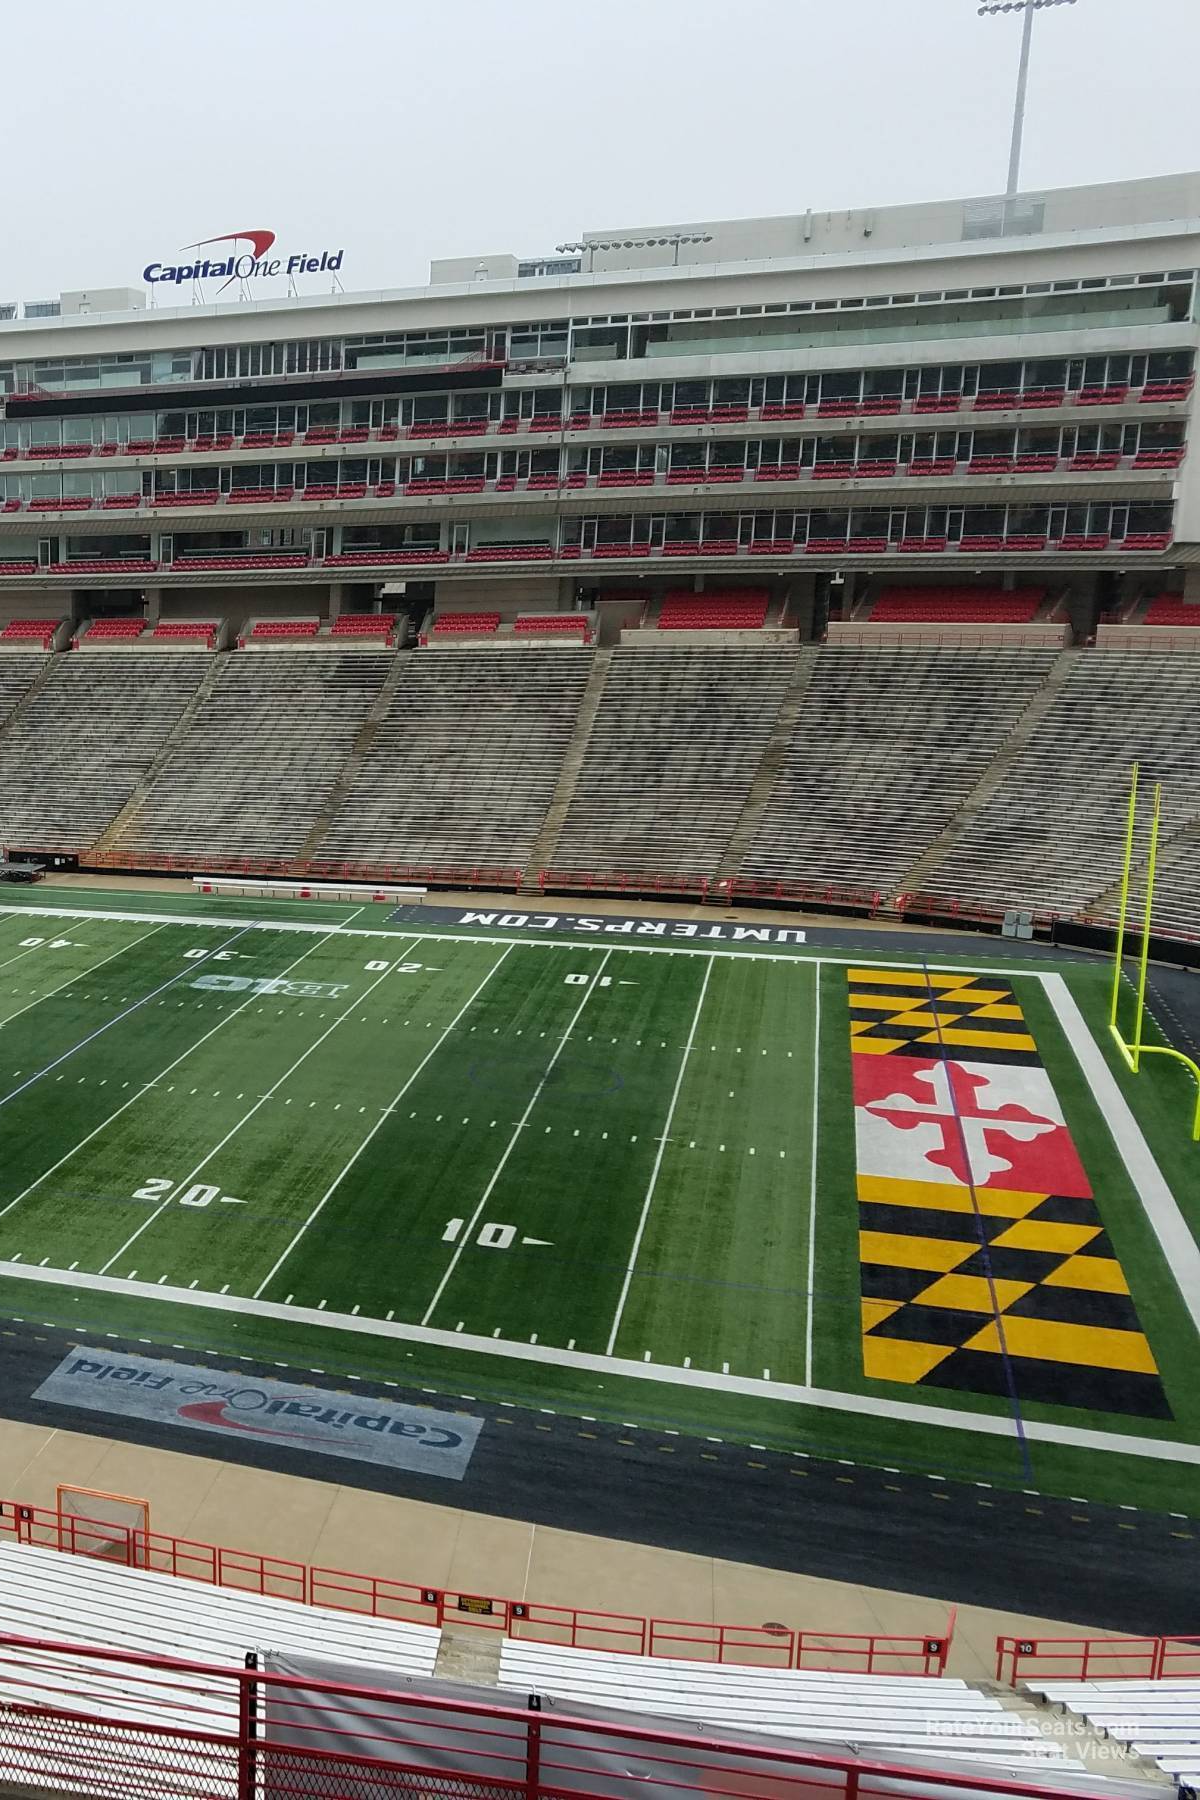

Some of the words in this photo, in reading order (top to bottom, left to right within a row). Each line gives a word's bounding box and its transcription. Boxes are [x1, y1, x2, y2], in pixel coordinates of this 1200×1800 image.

[287, 250, 344, 274] Field
[458, 912, 808, 943] UMTERPS.COM
[20, 937, 73, 949] 40
[184, 948, 238, 961] 30
[364, 960, 422, 973] 20
[564, 974, 612, 987] 10
[131, 1178, 221, 1208] 20
[442, 1217, 517, 1250] 10
[65, 1358, 175, 1391] Field
[427, 1593, 434, 1601] 8
[516, 1606, 523, 1615] 9
[930, 1643, 938, 1652] 9
[1020, 1645, 1033, 1653] 10
